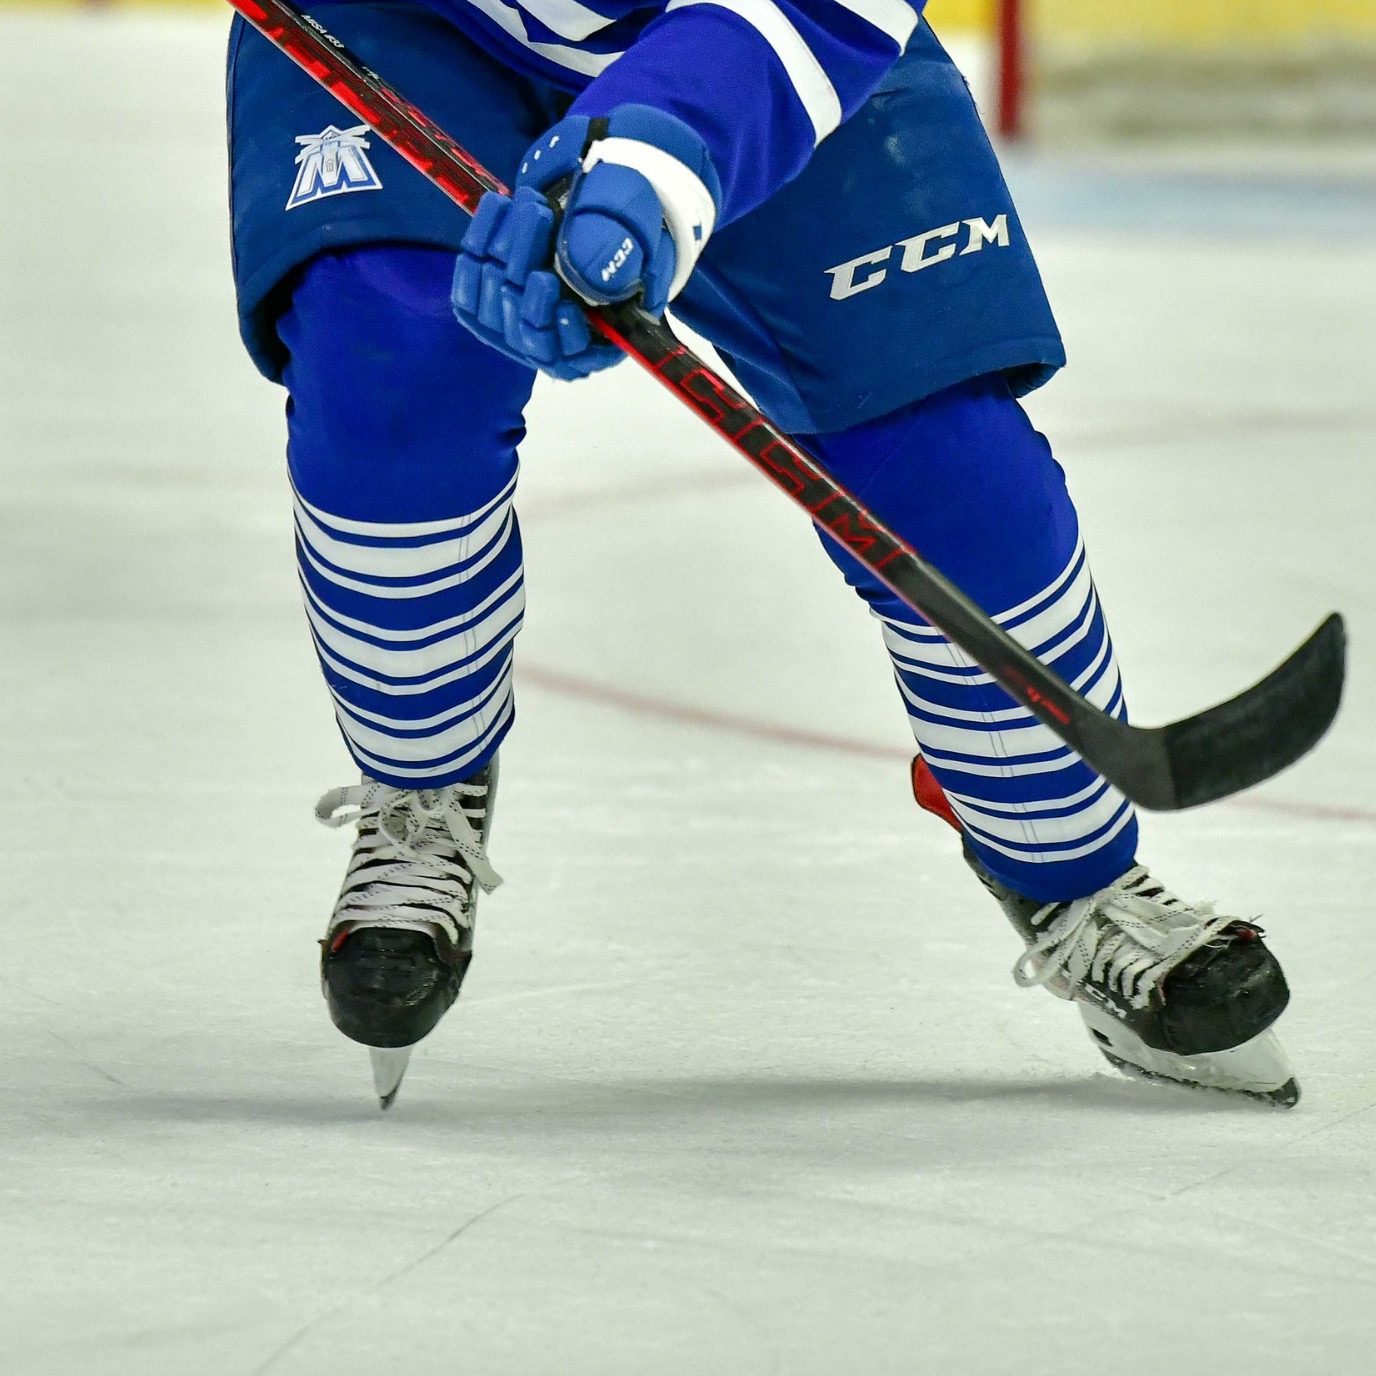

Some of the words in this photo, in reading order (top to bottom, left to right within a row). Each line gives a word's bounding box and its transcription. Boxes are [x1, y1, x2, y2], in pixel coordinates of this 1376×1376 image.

[601, 237, 634, 282] CCM
[824, 214, 1010, 301] CCM
[654, 344, 918, 570] CCM
